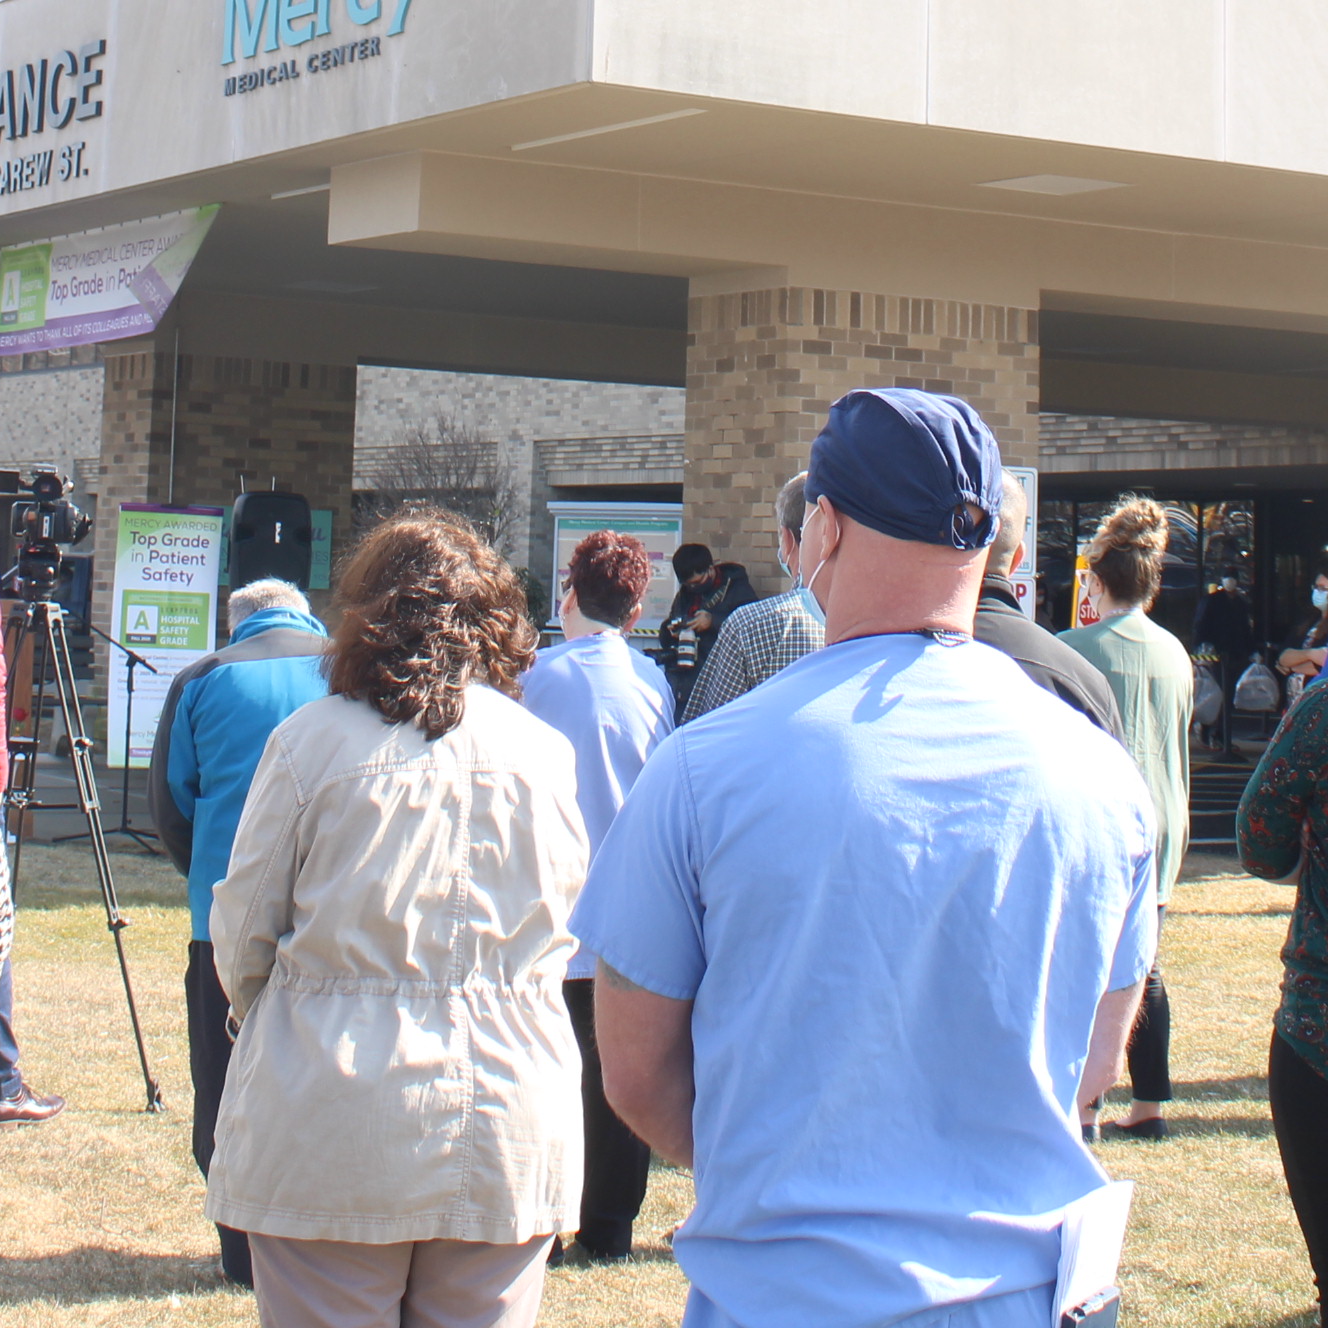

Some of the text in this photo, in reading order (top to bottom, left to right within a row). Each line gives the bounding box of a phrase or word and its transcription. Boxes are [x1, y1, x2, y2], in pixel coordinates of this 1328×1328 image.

[224, 36, 381, 97] MEDICAL CENTER
[58, 141, 89, 182] ST.
[51, 253, 80, 273] MERCY
[79, 247, 118, 268] MEDICAL
[119, 238, 155, 262] CENTER
[50, 279, 69, 307] Top
[70, 272, 104, 298] Grade
[105, 270, 116, 293] in
[125, 517, 218, 532] MERCY AWARDED
[130, 531, 210, 550] Top Grade
[131, 549, 207, 566] in Patient
[141, 567, 194, 587] Safety
[133, 609, 151, 631] A
[160, 615, 200, 625] HOSPITAL
[1080, 604, 1101, 619] STO
[160, 625, 189, 635] SAFETY
[160, 636, 188, 646] GRADE
